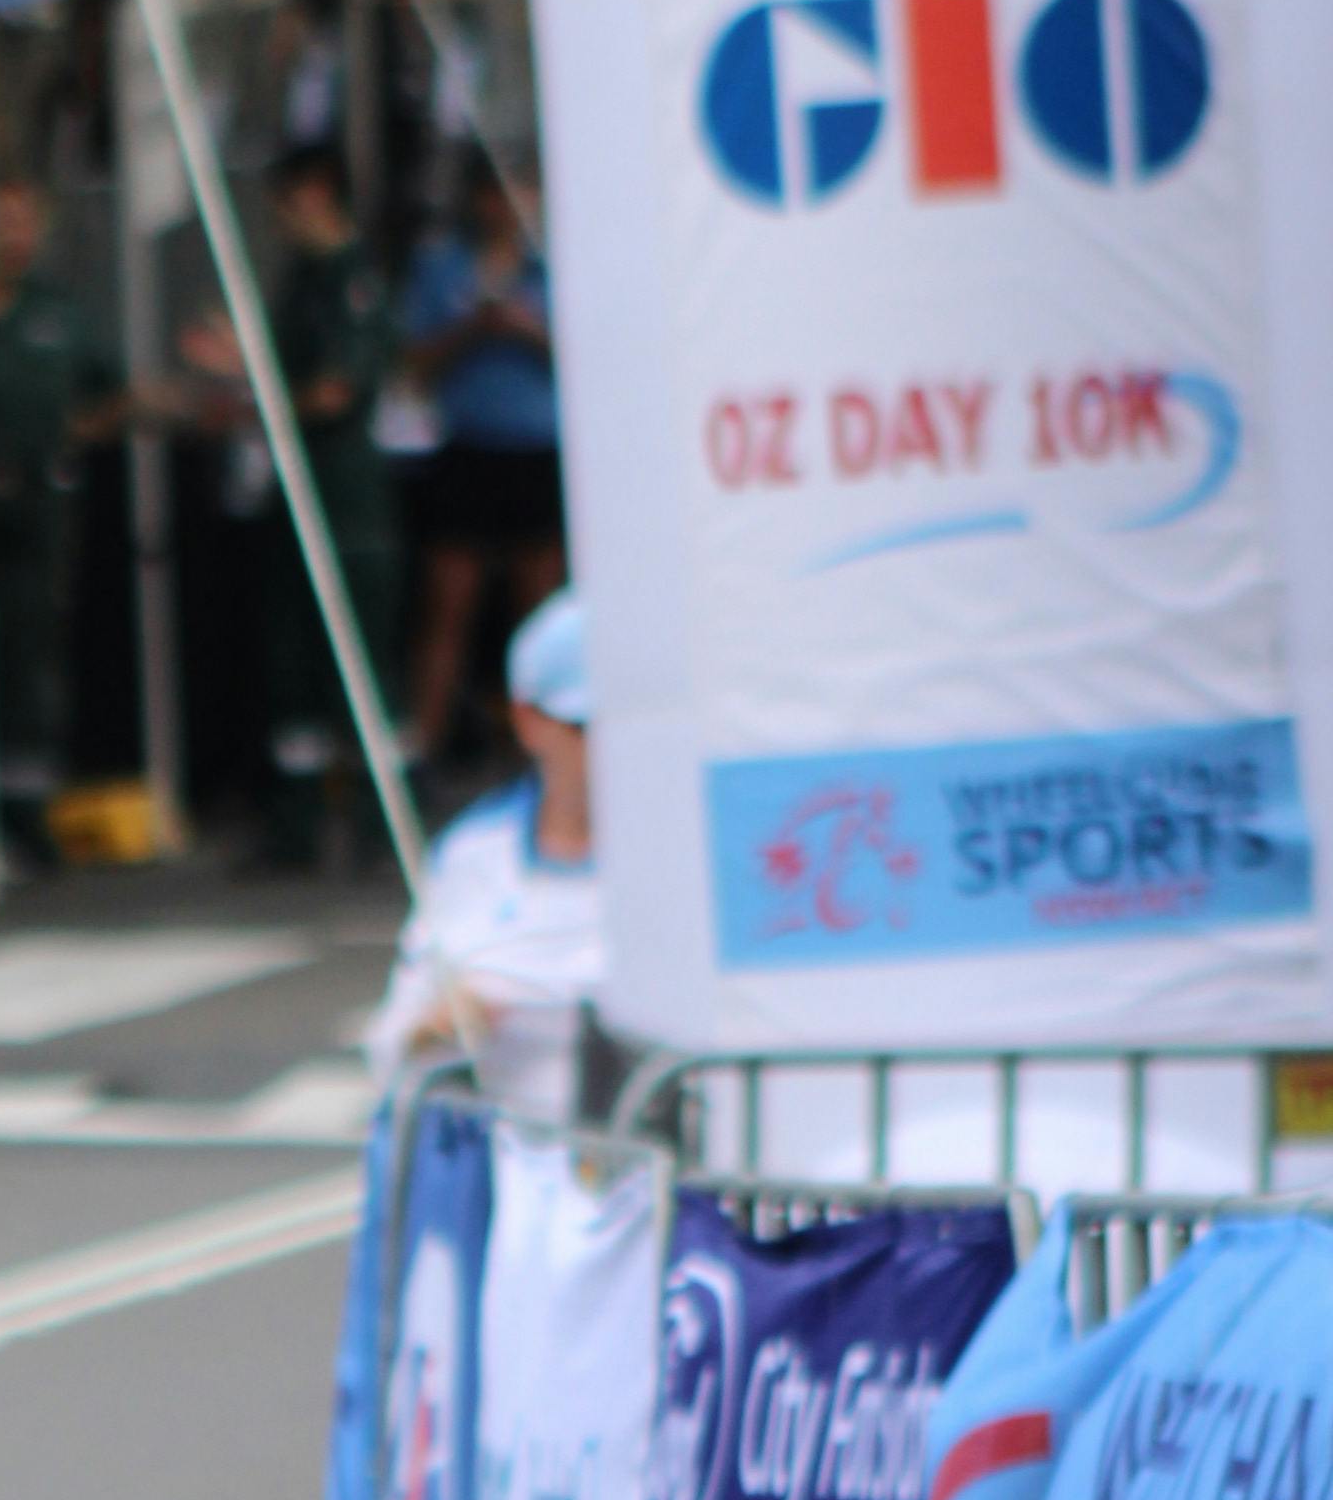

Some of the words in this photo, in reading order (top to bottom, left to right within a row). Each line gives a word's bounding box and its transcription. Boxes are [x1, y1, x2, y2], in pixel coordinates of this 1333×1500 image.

[703, 390, 798, 494] OZ
[827, 376, 993, 482] DAY
[1026, 366, 1178, 468] 10K
